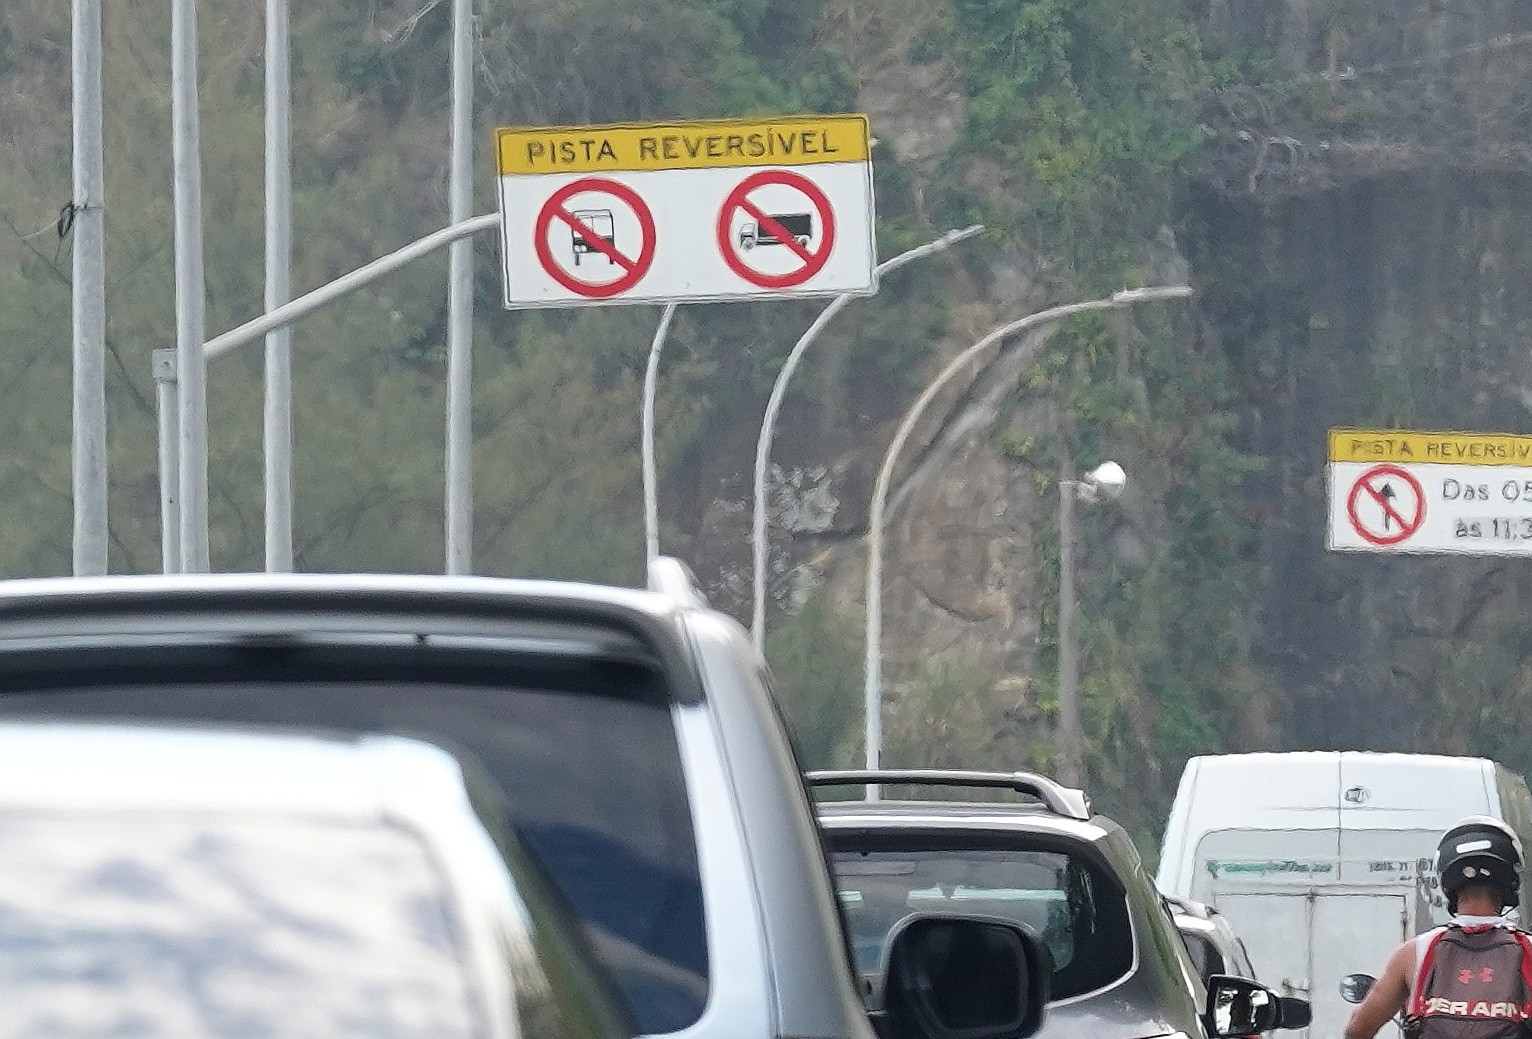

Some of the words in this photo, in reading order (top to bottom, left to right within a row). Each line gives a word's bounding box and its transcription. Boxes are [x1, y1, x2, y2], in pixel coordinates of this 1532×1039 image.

[527, 138, 617, 165] PISTA
[639, 128, 838, 162] REVERSÍVEL
[1350, 439, 1414, 457] PISTA
[1443, 478, 1489, 501] Das
